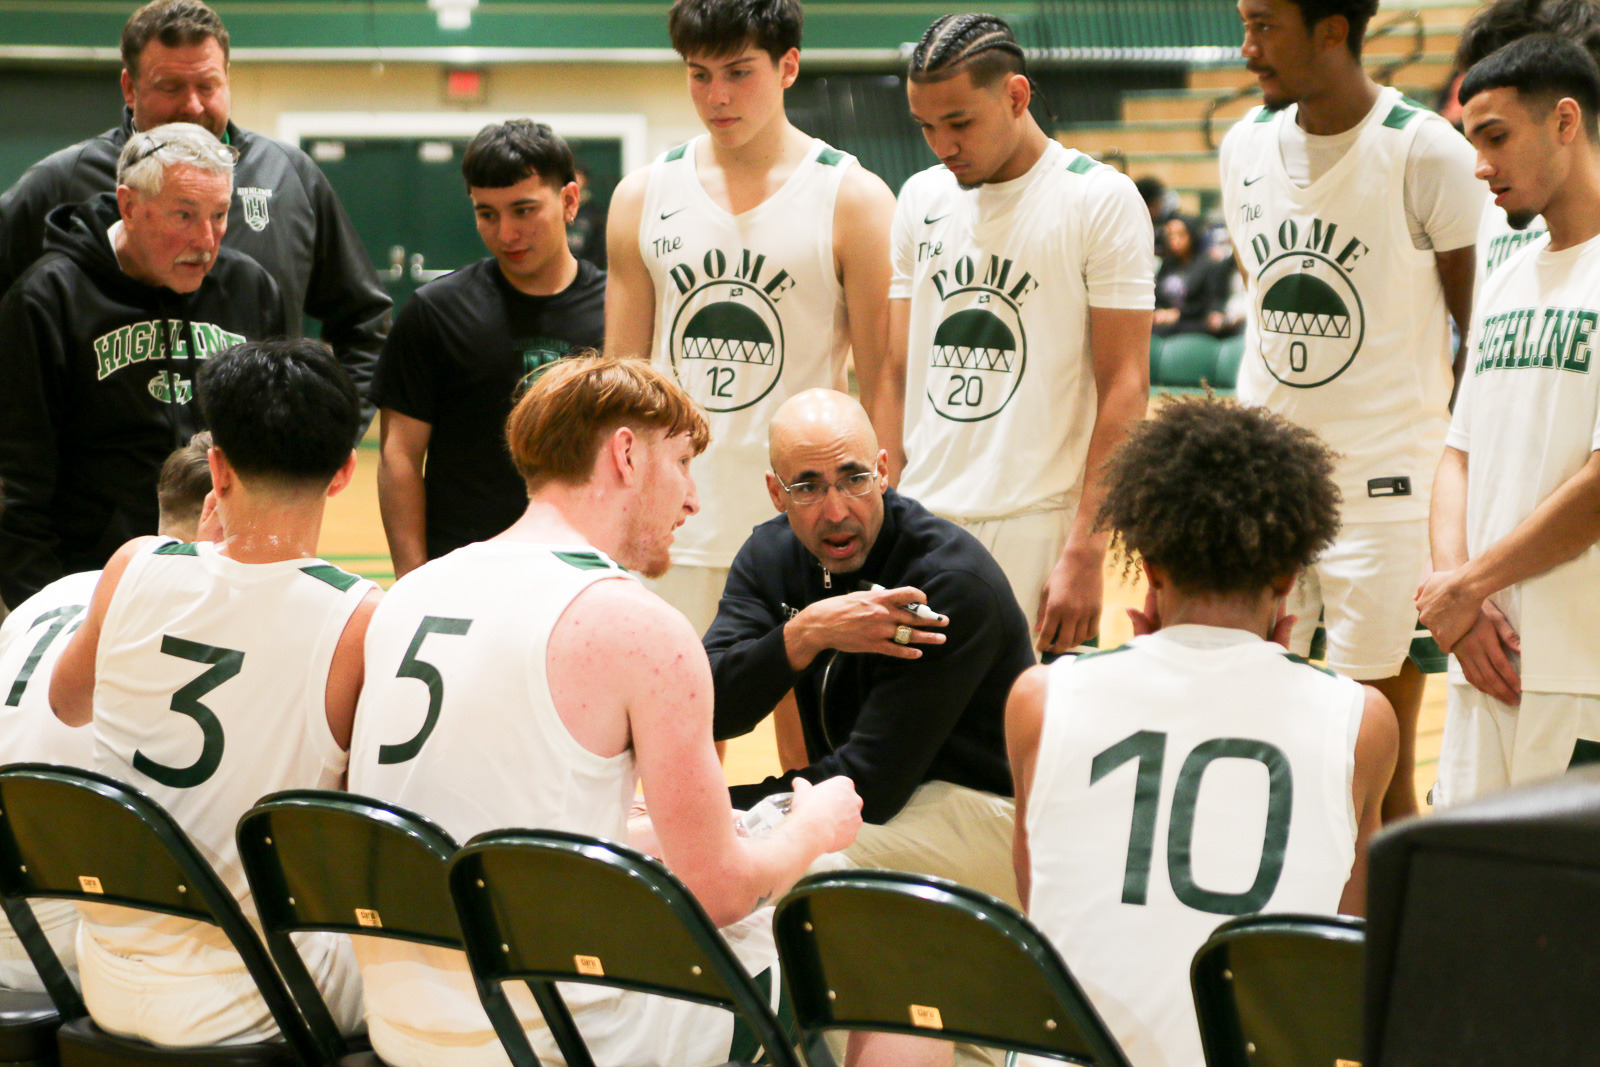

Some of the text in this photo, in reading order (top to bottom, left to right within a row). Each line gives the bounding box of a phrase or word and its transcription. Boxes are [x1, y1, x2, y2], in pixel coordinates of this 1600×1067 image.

[1240, 203, 1263, 224] The
[652, 235, 684, 258] The
[918, 240, 944, 262] The
[1251, 218, 1370, 273] DOME
[669, 248, 797, 303] DOME
[931, 253, 1040, 307] DOME
[1289, 340, 1308, 373] 0
[706, 365, 736, 398] 12
[946, 374, 984, 407] 20
[132, 634, 246, 788] 3
[378, 615, 474, 765] 5
[1089, 729, 1294, 916] 10
